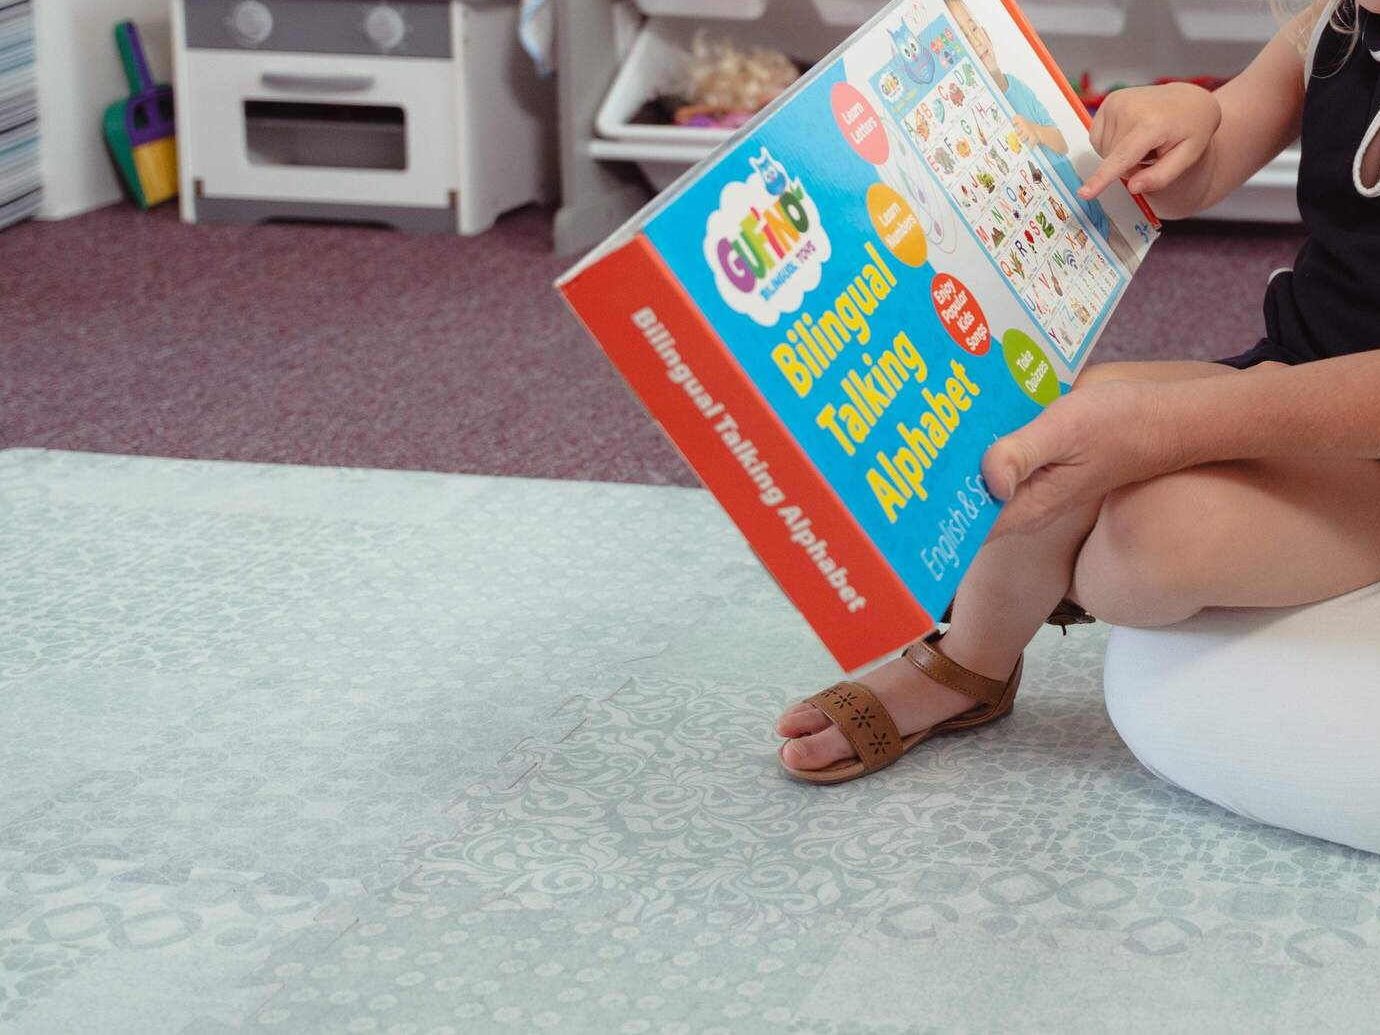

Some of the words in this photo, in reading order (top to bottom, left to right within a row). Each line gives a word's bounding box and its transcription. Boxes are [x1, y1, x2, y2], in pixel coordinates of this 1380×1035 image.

[841, 102, 865, 125] Learn
[904, 119, 915, 135] A
[921, 102, 932, 118] B
[937, 85, 949, 101] C
[850, 117, 878, 145] Letters
[927, 155, 939, 172] E
[944, 137, 953, 154] F
[960, 119, 972, 135] G
[975, 101, 987, 118] H
[969, 172, 978, 188] J
[997, 138, 1009, 152] L
[878, 202, 901, 227] Learn
[976, 225, 990, 244] M
[991, 206, 1005, 224] N
[1006, 186, 1017, 202] O
[1020, 169, 1029, 185] P
[885, 214, 917, 250] Numbers
[1000, 261, 1014, 277] Q
[1015, 239, 1027, 257] R
[1029, 220, 1041, 236] S
[796, 240, 816, 264] TOYS
[1024, 294, 1036, 311] U
[1039, 272, 1051, 290] V
[1052, 250, 1066, 269] W
[1065, 232, 1077, 249] X
[934, 279, 956, 305] Enjoy
[941, 290, 968, 325] Popular
[771, 241, 897, 398] Bilingual
[957, 310, 975, 333] Kids
[965, 323, 988, 351] Songs
[1048, 327, 1061, 344] Y
[1016, 349, 1034, 372] Take
[1025, 360, 1049, 393] Quizzes
[816, 331, 928, 456] Talking
[866, 358, 981, 524] Alphabet
[631, 306, 725, 418] Bilingual
[714, 412, 785, 506] Talking
[777, 505, 867, 613] Alphabet
[920, 507, 970, 581] English
[957, 490, 978, 519] &
